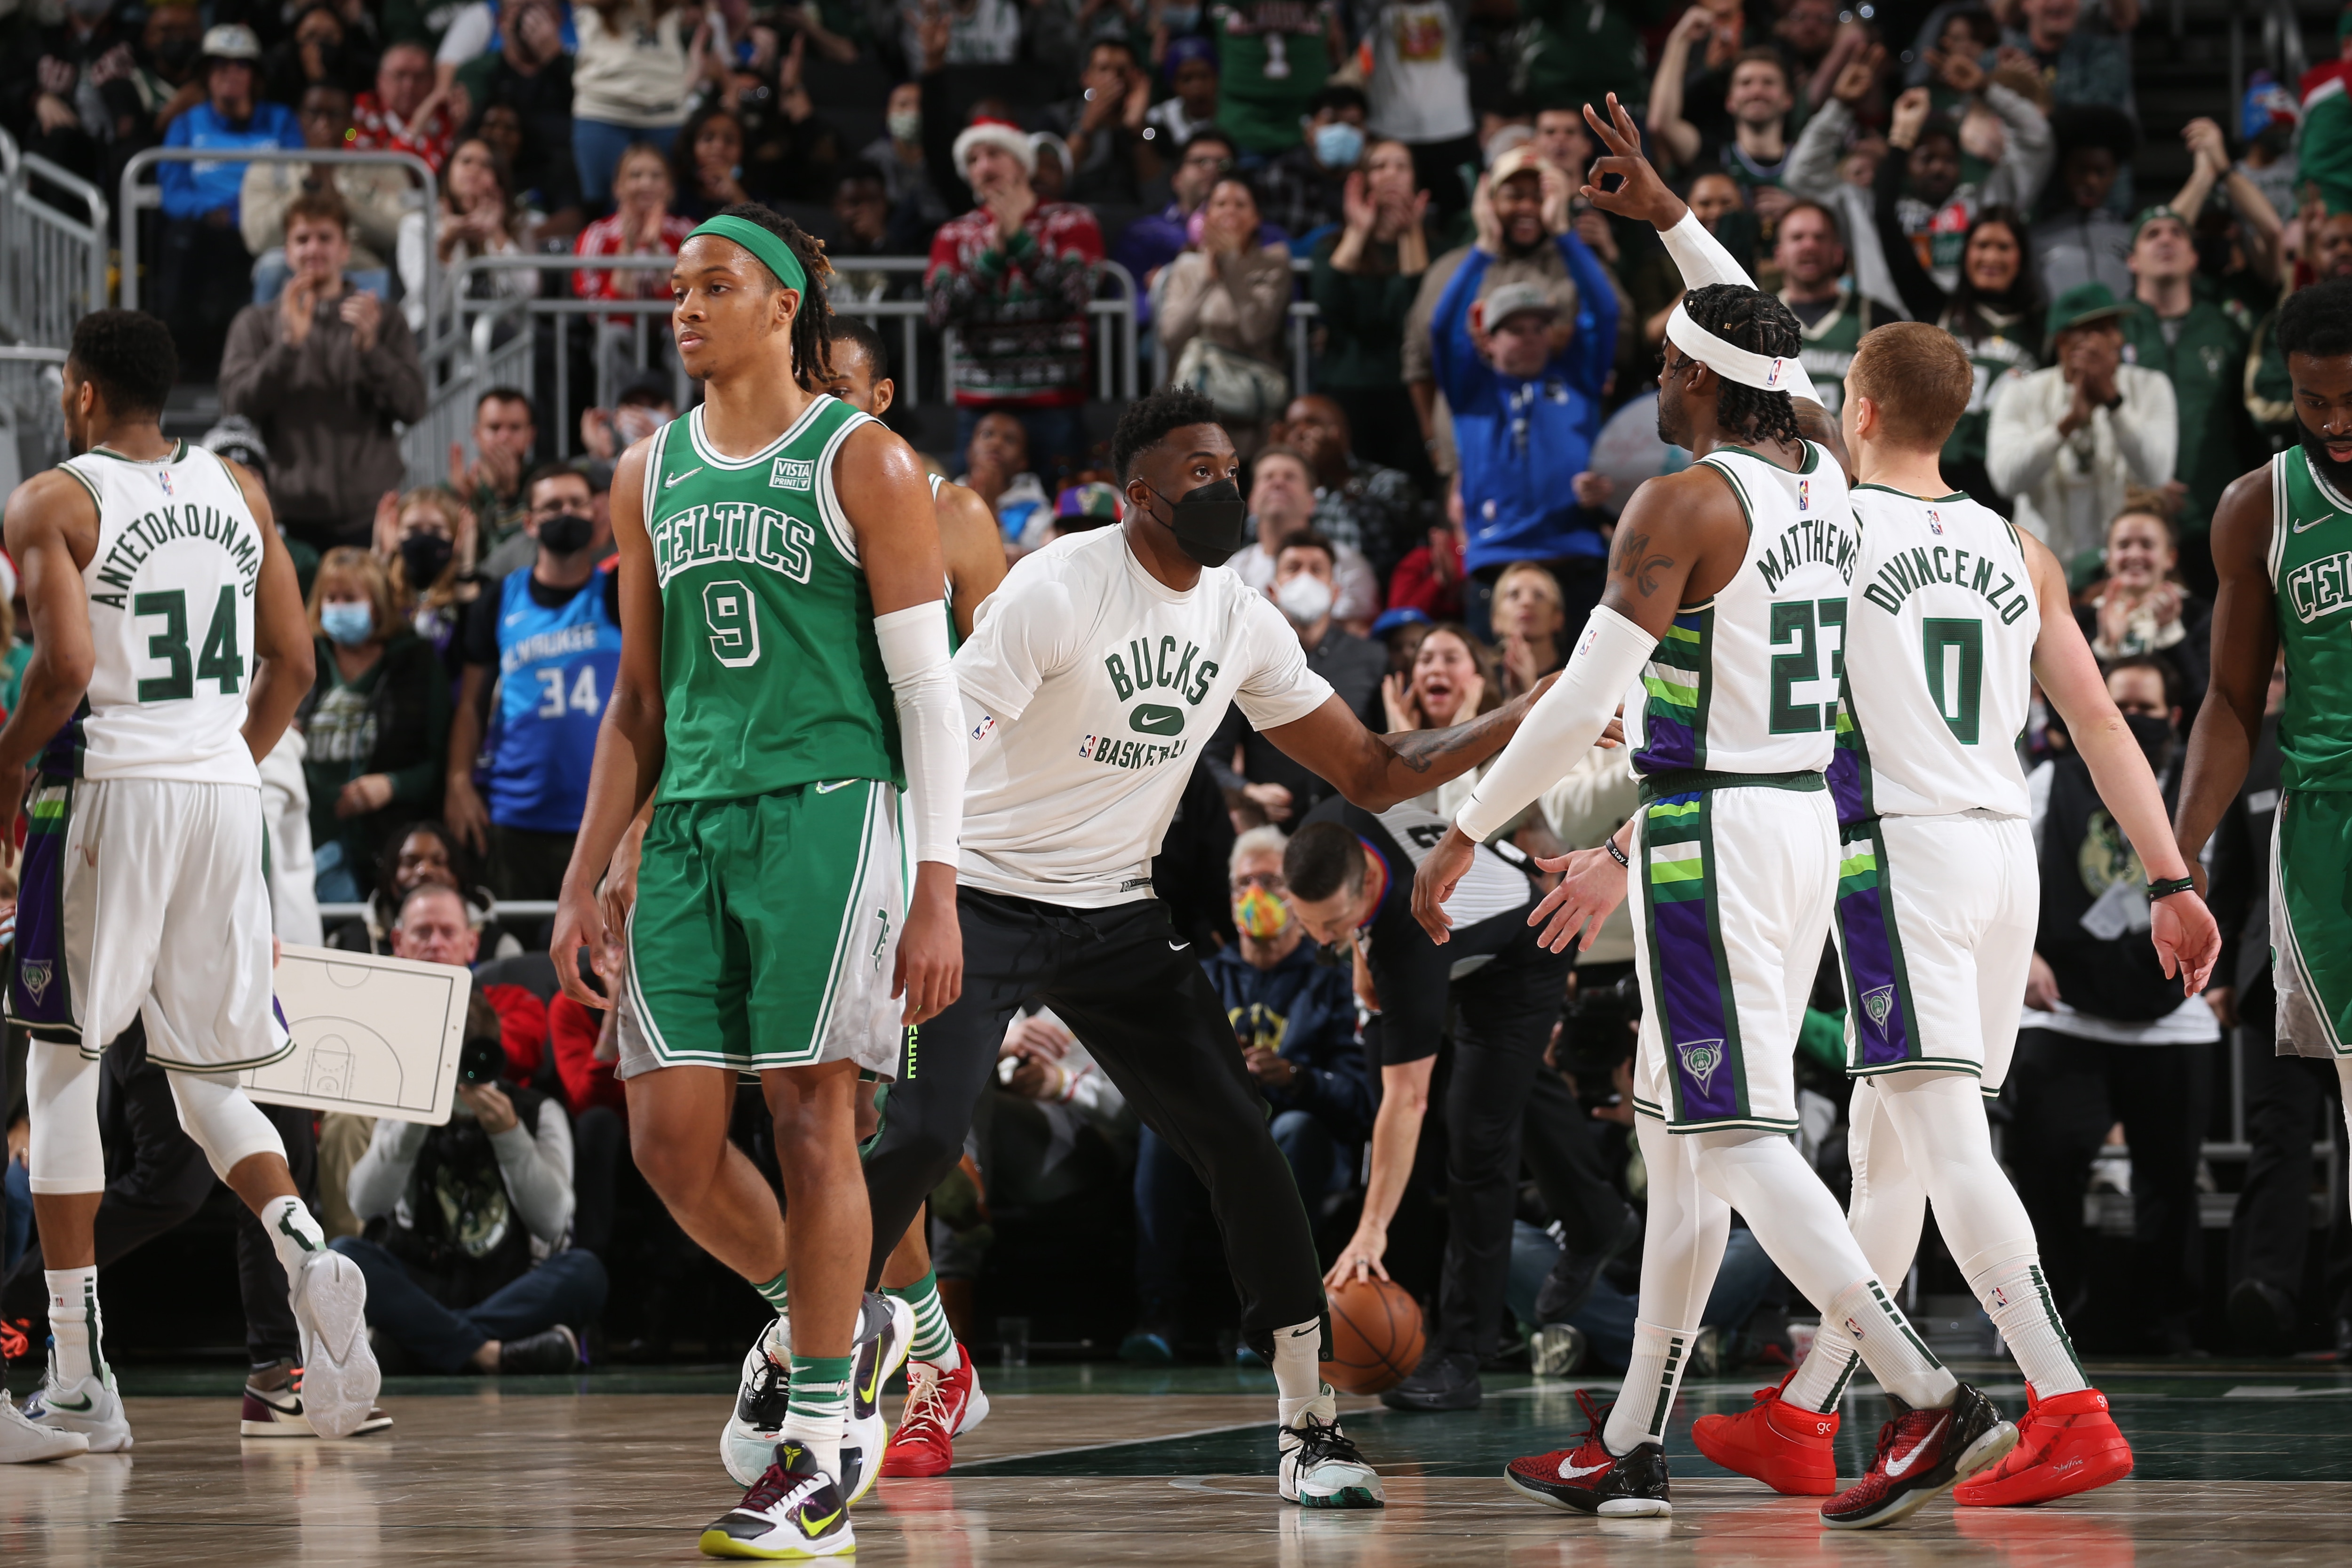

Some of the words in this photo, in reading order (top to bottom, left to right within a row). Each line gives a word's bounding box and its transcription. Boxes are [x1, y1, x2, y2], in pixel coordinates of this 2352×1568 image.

[774, 477, 797, 486] PRINT
[778, 462, 809, 477] VISTA
[91, 503, 257, 610] ANTETOKOUNMPO
[653, 501, 815, 589] CELTICS
[1756, 519, 1858, 594] MATTHEWS
[702, 580, 760, 668] 9
[1863, 546, 2028, 626] DIVINCENZO
[135, 584, 244, 702] 34
[1104, 635, 1219, 706] BUCKS
[1923, 617, 1982, 745] 0
[535, 664, 600, 719] 34
[1611, 848, 1626, 863] Stay
